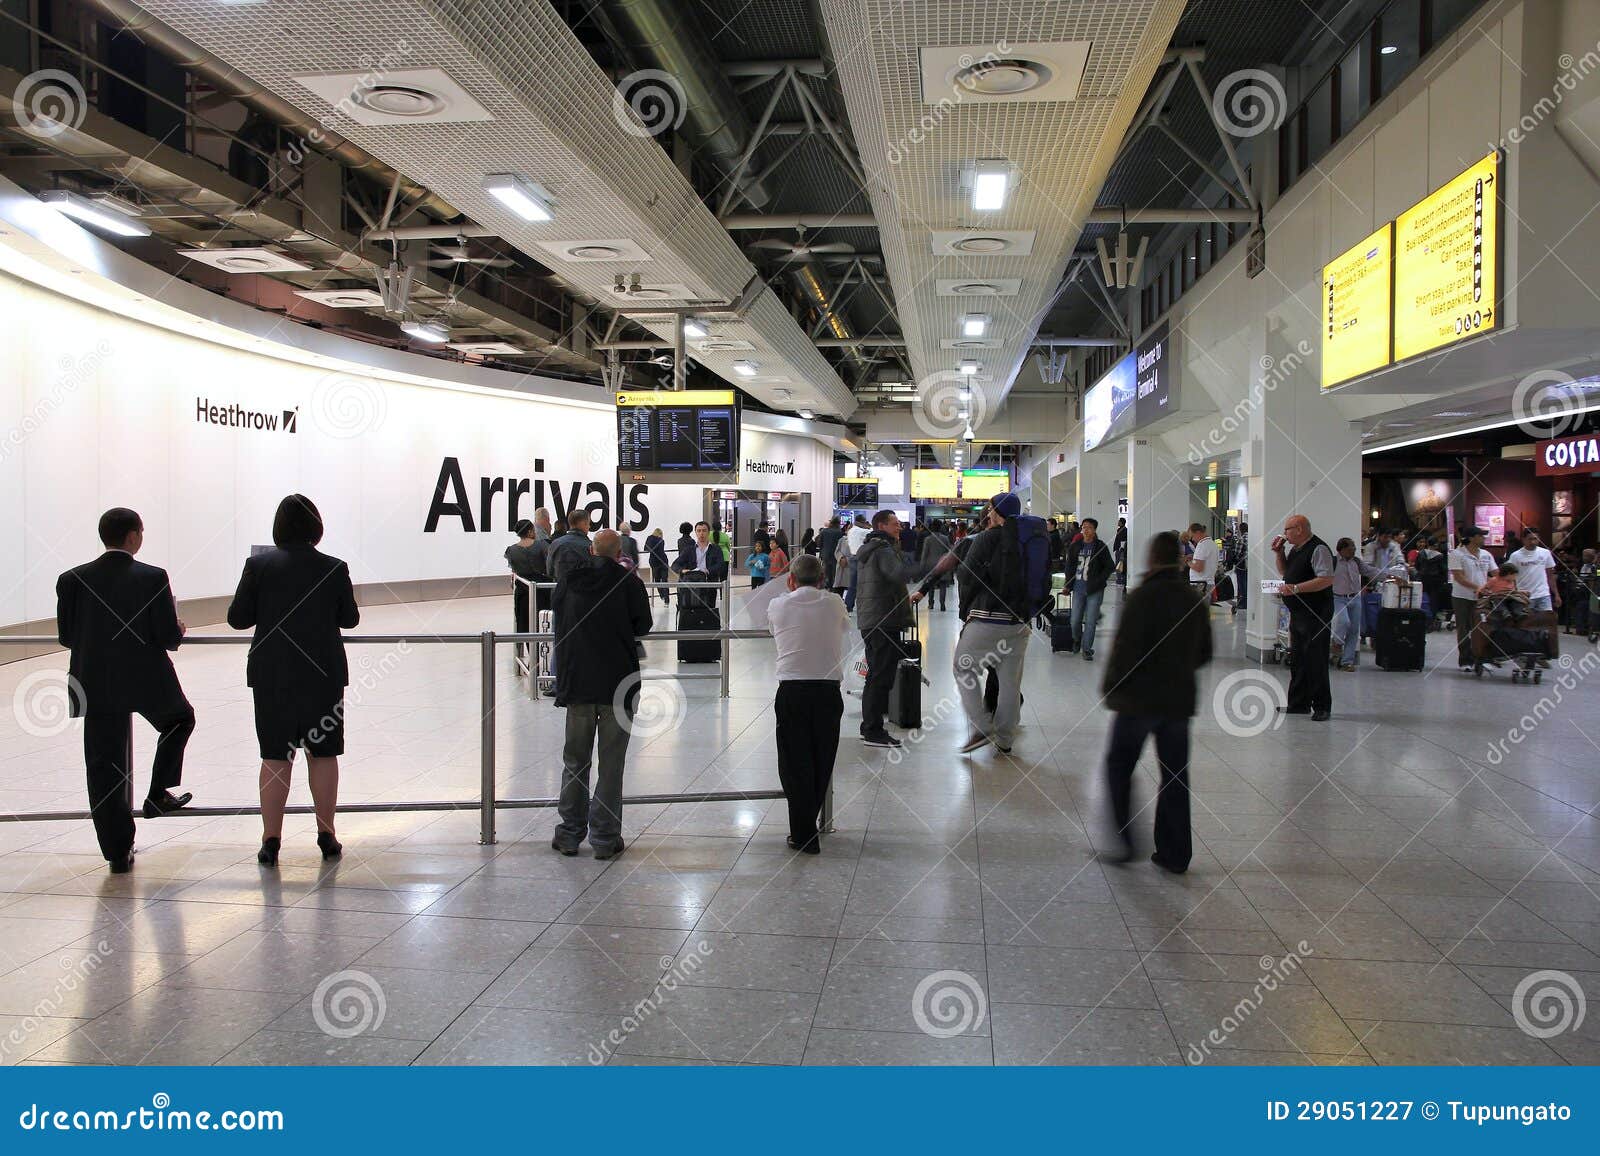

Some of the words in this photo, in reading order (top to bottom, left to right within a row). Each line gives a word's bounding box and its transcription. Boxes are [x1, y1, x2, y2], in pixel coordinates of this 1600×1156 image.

[1435, 187, 1473, 217] information
[1435, 205, 1473, 231] information
[1431, 222, 1473, 253] Underground
[1456, 257, 1473, 272] Taxis
[196, 396, 278, 431] Heathrow
[745, 458, 785, 475] Heathrow
[1545, 438, 1600, 467] COSTA
[423, 456, 649, 532] Arrivals
